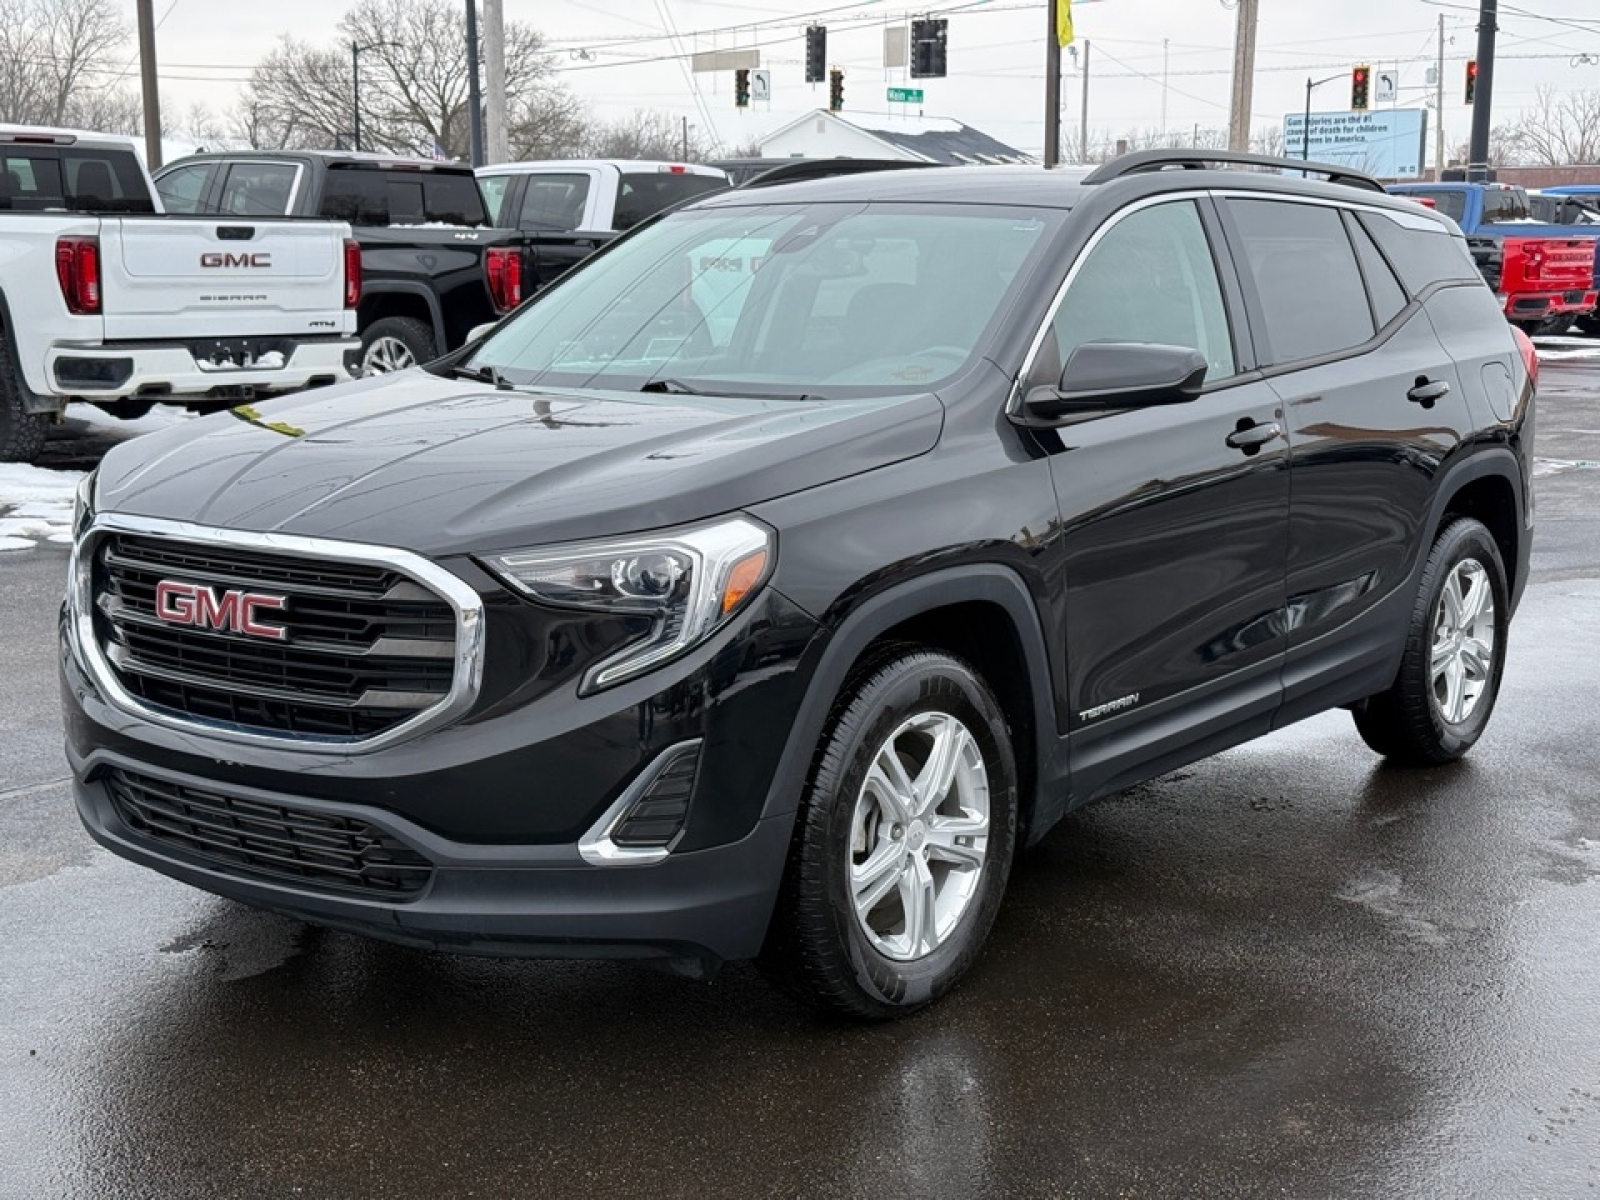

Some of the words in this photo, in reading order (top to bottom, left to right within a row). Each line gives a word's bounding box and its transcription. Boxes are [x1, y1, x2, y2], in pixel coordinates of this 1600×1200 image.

[1287, 117, 1302, 126] Gun
[1305, 116, 1332, 127] juries
[1310, 126, 1318, 135] of
[1319, 125, 1340, 134] death
[1342, 125, 1354, 134] for
[1356, 123, 1388, 133] children
[1287, 136, 1300, 145] and
[1303, 136, 1322, 144] tens
[1325, 135, 1332, 144] in
[200, 252, 272, 268] GMC
[156, 579, 287, 641] GMC
[1079, 692, 1139, 721] TERRAIN
